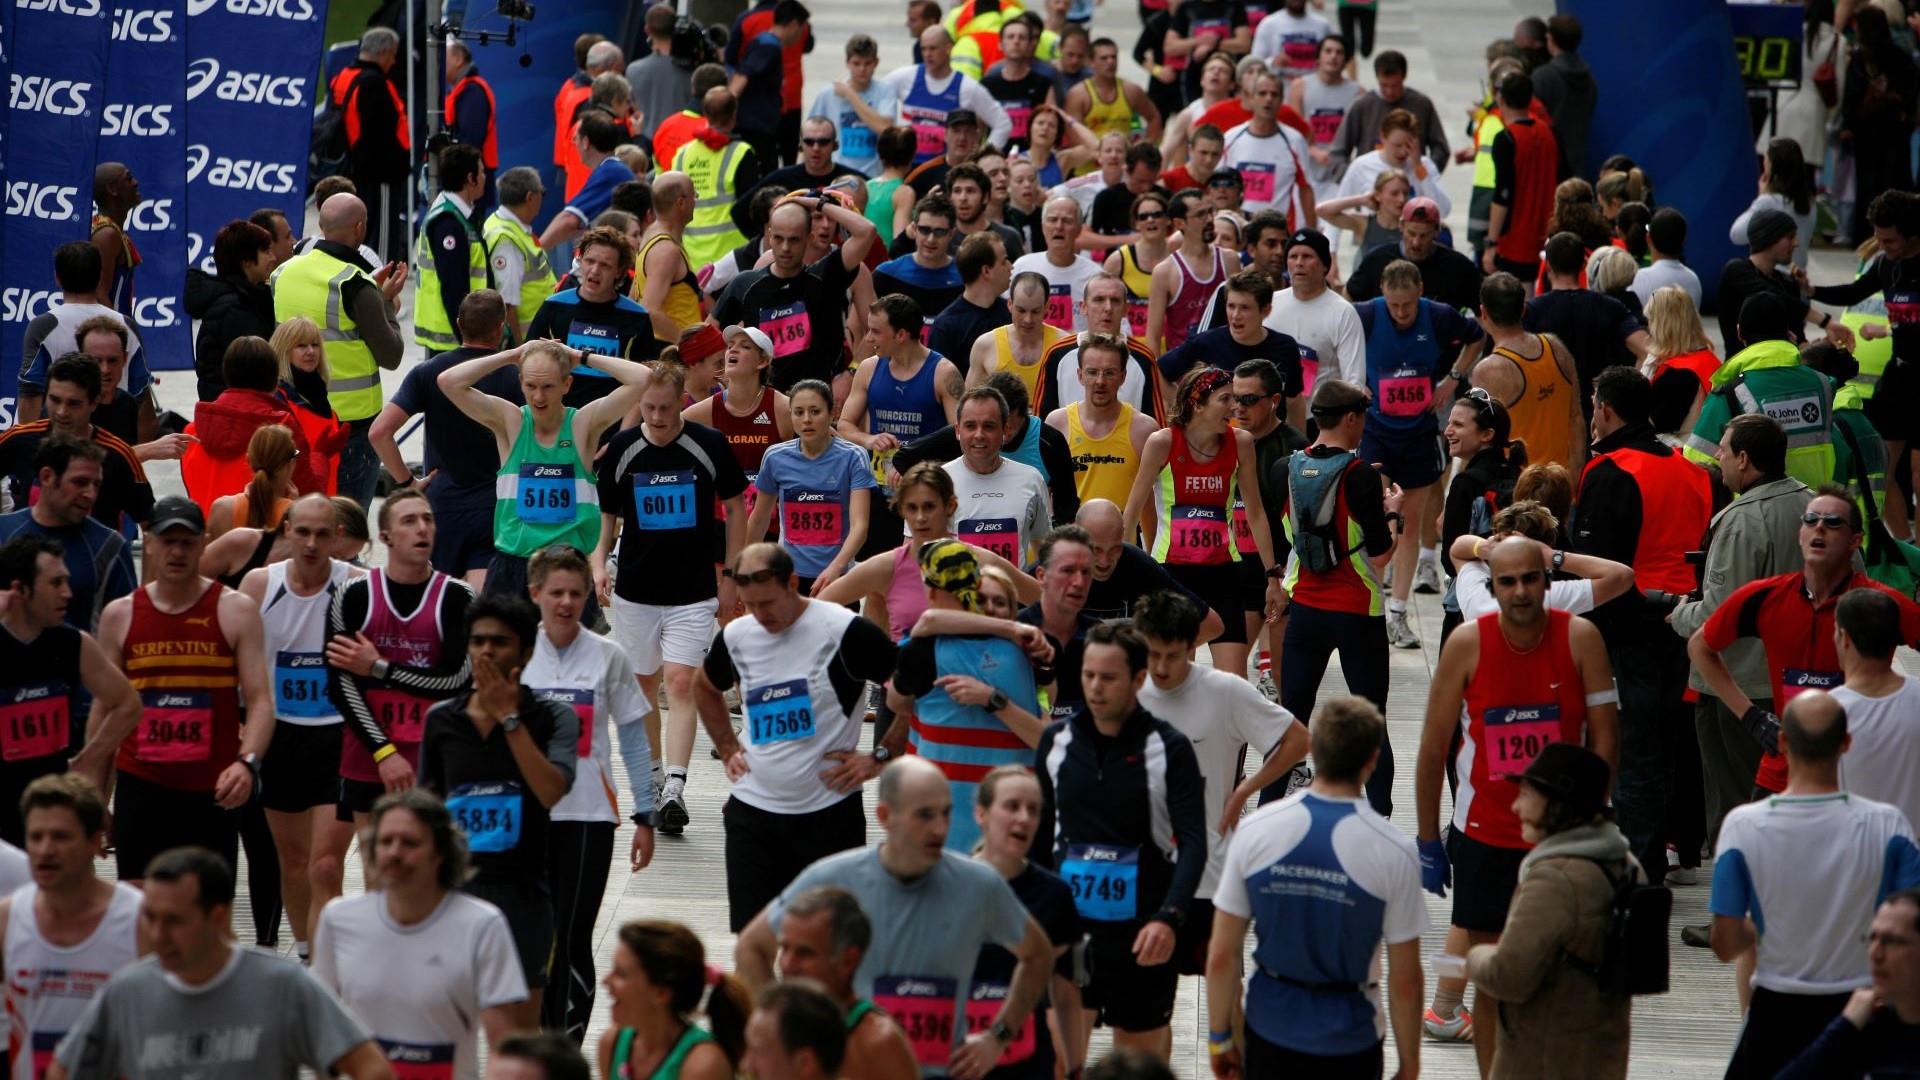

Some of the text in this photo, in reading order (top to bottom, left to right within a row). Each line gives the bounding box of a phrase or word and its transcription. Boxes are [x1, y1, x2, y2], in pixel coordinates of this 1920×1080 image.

[876, 409, 922, 422] WORCESTER
[1778, 407, 1800, 418] John
[1185, 476, 1222, 490] FETCH
[525, 488, 570, 508] 5159
[643, 494, 686, 515] 6011
[1180, 528, 1222, 548] 1380
[131, 641, 217, 657] SERPENTINE
[754, 708, 811, 740] 17569
[1270, 864, 1348, 887] PACEMAKER
[1071, 873, 1127, 902] 5749
